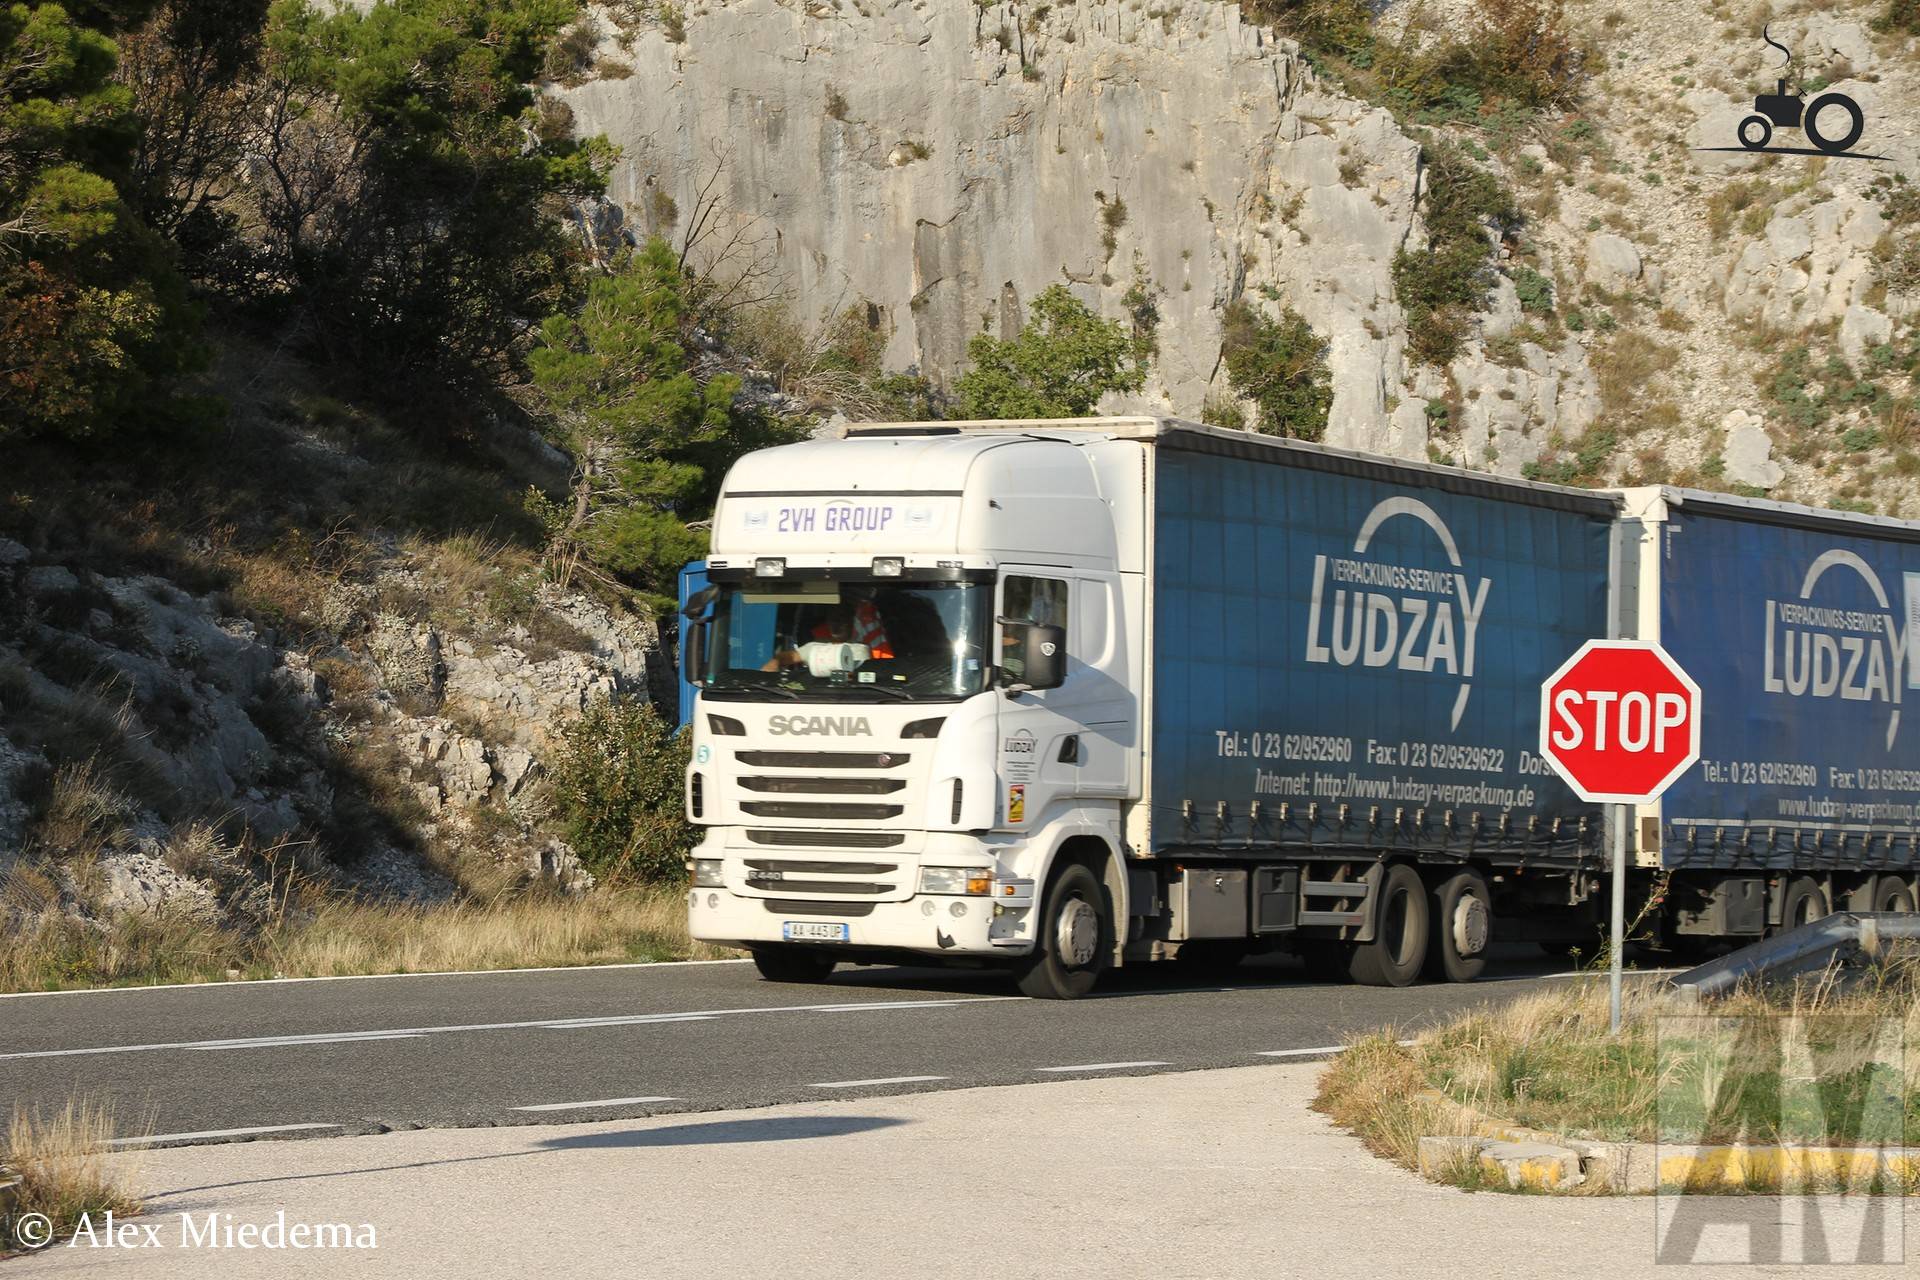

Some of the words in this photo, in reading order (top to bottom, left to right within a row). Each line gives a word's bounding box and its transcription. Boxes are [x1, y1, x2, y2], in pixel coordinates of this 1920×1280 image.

[778, 508, 816, 532] 2VH
[825, 507, 893, 531] GROUP
[1331, 558, 1454, 595] VERPACKUNGS-SERVICE
[1306, 555, 1492, 677] LUDZAY
[1779, 602, 1883, 633] VERPACKUNGS-SERVICE
[1764, 600, 1909, 704] LUDZAY
[768, 715, 873, 736] SCANIA
[1552, 689, 1687, 753] STOP
[1216, 730, 1247, 757] Tel.:
[1252, 732, 1261, 758] 0
[1264, 733, 1281, 759] 23
[1367, 739, 1397, 766] Fax:
[1400, 742, 1408, 767] 0
[1411, 743, 1427, 768] 23
[1255, 768, 1310, 796] Internet:
[1313, 771, 1535, 812] http://www.ludzay-verpackung.de
[1702, 760, 1728, 783] Tel.:
[1742, 763, 1757, 785] 23
[1830, 767, 1855, 789] Fax:
